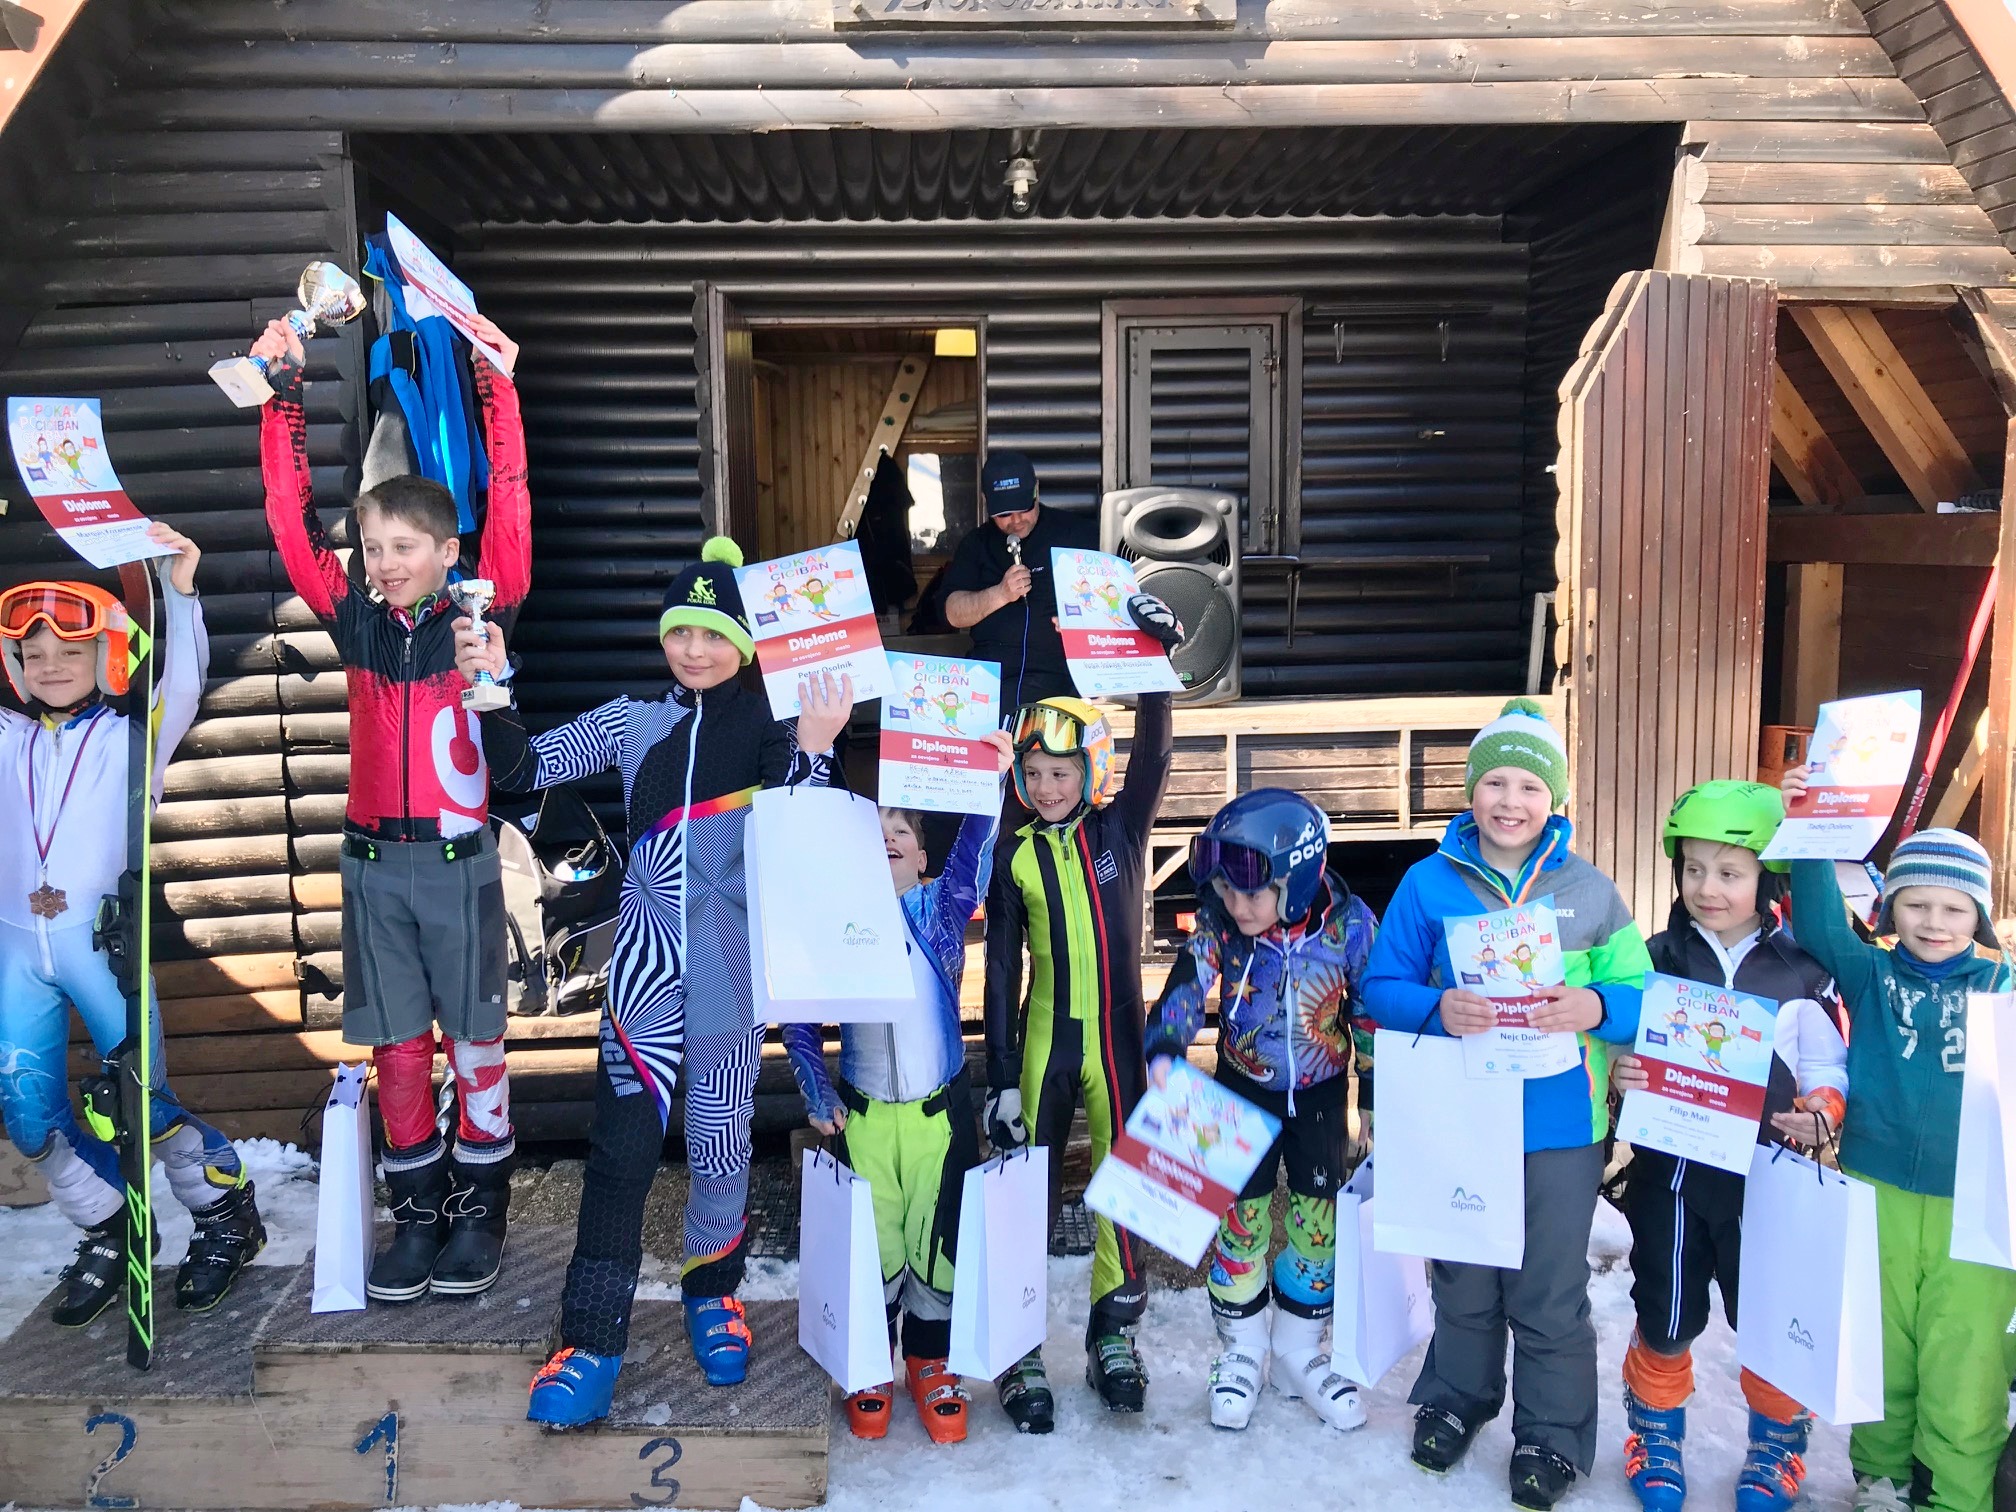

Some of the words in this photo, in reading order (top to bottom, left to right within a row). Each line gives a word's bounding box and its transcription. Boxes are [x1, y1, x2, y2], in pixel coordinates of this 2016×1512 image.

[62, 499, 112, 514] Diploma
[767, 552, 824, 575] POKAL
[770, 561, 829, 582] CICIBAN
[788, 628, 848, 652] Diploma
[1088, 634, 1136, 648] Diploma
[798, 667, 820, 679] Peter
[821, 660, 853, 675] Osolnik
[914, 660, 969, 676] POKAL
[914, 672, 970, 687] CICIBAN
[911, 738, 969, 756] Diploma
[943, 754, 949, 764] 4
[1817, 791, 1870, 805] Diploma
[1478, 910, 1534, 932] POKAL
[1480, 923, 1537, 944] CICIBAN
[1677, 983, 1739, 1008] POKAL
[1677, 996, 1740, 1020] CICIBAN
[1500, 1032, 1520, 1042] Nejc
[1665, 1068, 1729, 1097] Diploma
[1669, 1105, 1688, 1118] Filip
[1690, 1110, 1710, 1124] Mali
[85, 1413, 139, 1509] 2
[354, 1411, 399, 1504] 1
[630, 1437, 683, 1507] 3
